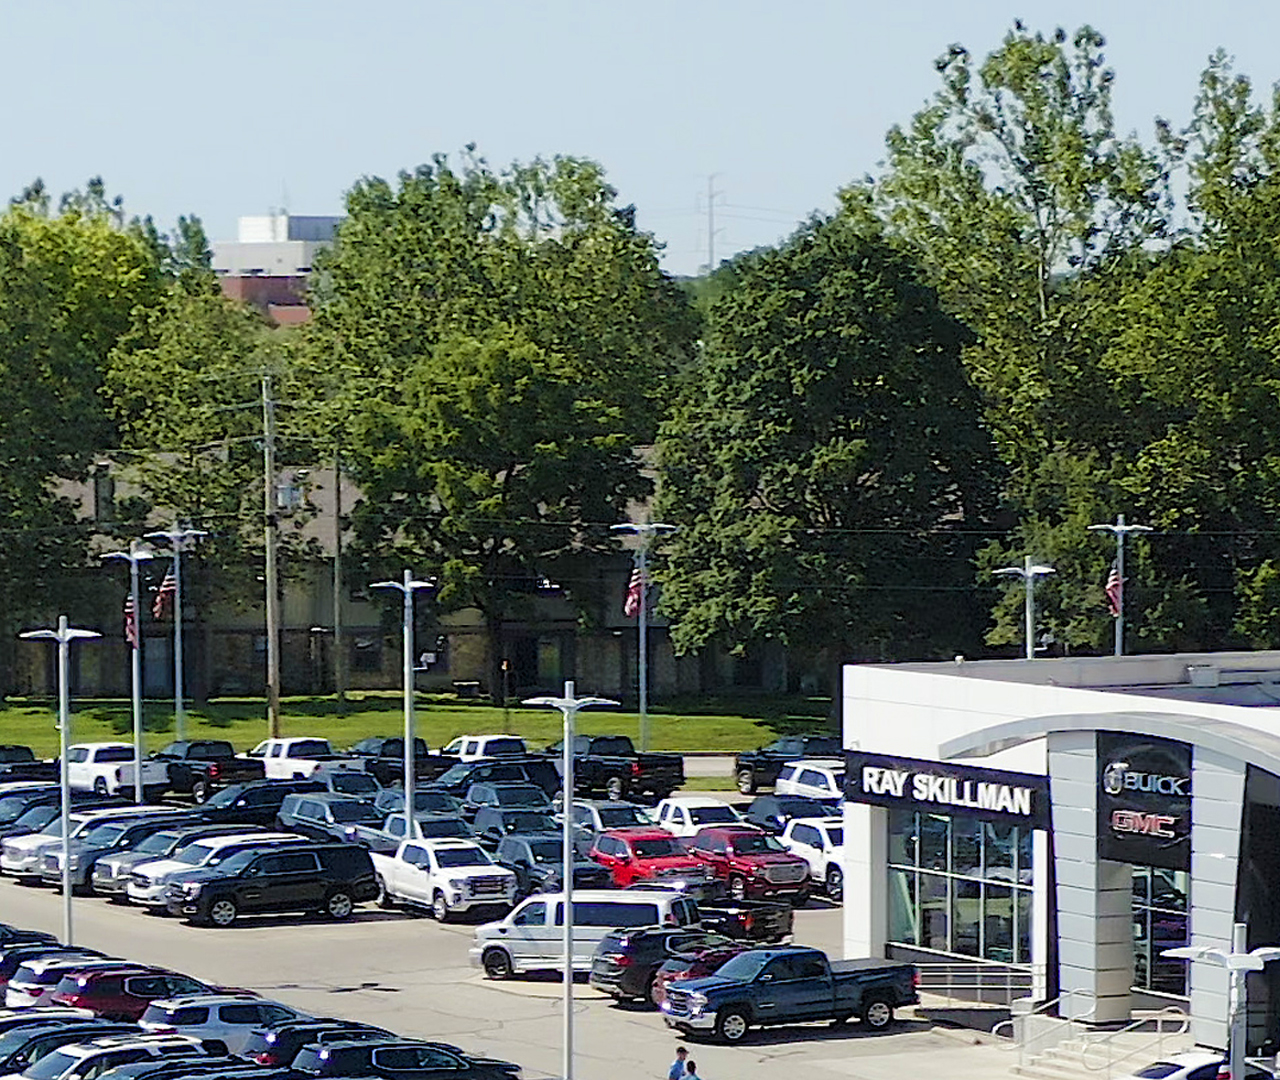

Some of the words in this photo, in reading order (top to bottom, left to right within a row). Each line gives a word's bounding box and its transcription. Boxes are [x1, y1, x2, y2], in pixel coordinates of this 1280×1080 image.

[863, 766, 909, 797] RAY
[912, 773, 1031, 815] SKILLMAN
[1124, 771, 1189, 796] BUICK
[1111, 810, 1176, 838] GMC
